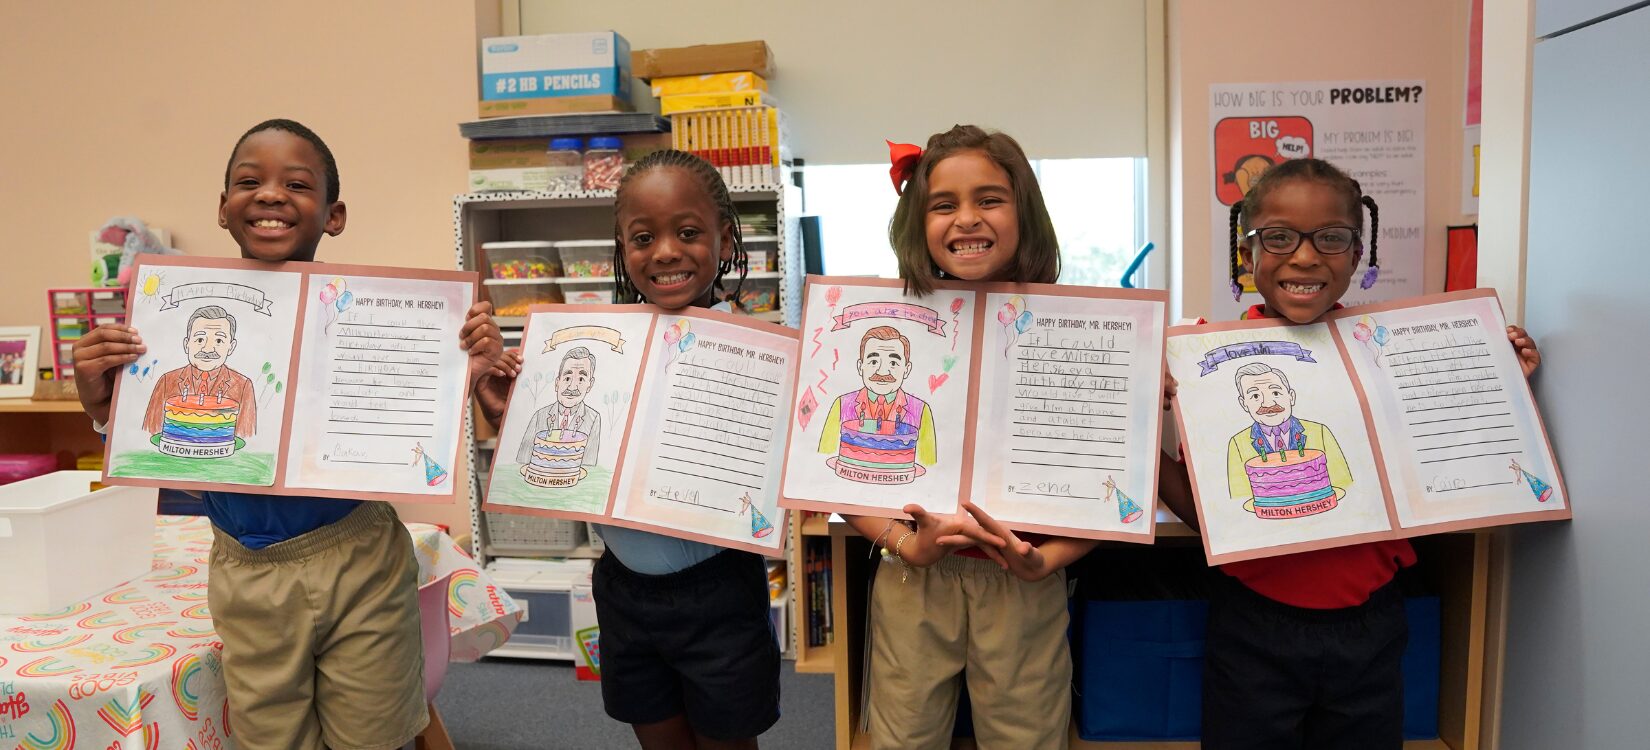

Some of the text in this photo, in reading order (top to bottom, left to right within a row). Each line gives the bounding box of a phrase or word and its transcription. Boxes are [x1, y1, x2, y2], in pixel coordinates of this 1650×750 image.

[520, 77, 537, 92] HB
[544, 73, 600, 90] PENCILS
[1214, 86, 1423, 107] HOW BIG IS YOUR PROBLEM?
[1249, 121, 1280, 138] BIG
[1282, 142, 1303, 153] HELP!
[355, 297, 374, 307] HAPPY
[1036, 318, 1056, 328] HAPPY
[1058, 319, 1087, 331] BIRTHDAY,
[1103, 322, 1132, 331] HERSHEY!
[1391, 327, 1411, 337] HAPPY
[698, 340, 716, 350] HAPPY
[1027, 329, 1115, 350] If I could
[163, 444, 230, 456] MILTON HERSHEY
[527, 474, 576, 486] MILTON HERSHEY
[839, 467, 910, 482] MILTON HERSHEY
[1008, 485, 1015, 493] BY
[1426, 485, 1433, 493] BY
[1260, 499, 1333, 517] MILTON HERSHEY
[485, 584, 504, 616] appy
[69, 677, 136, 700] GOOD
